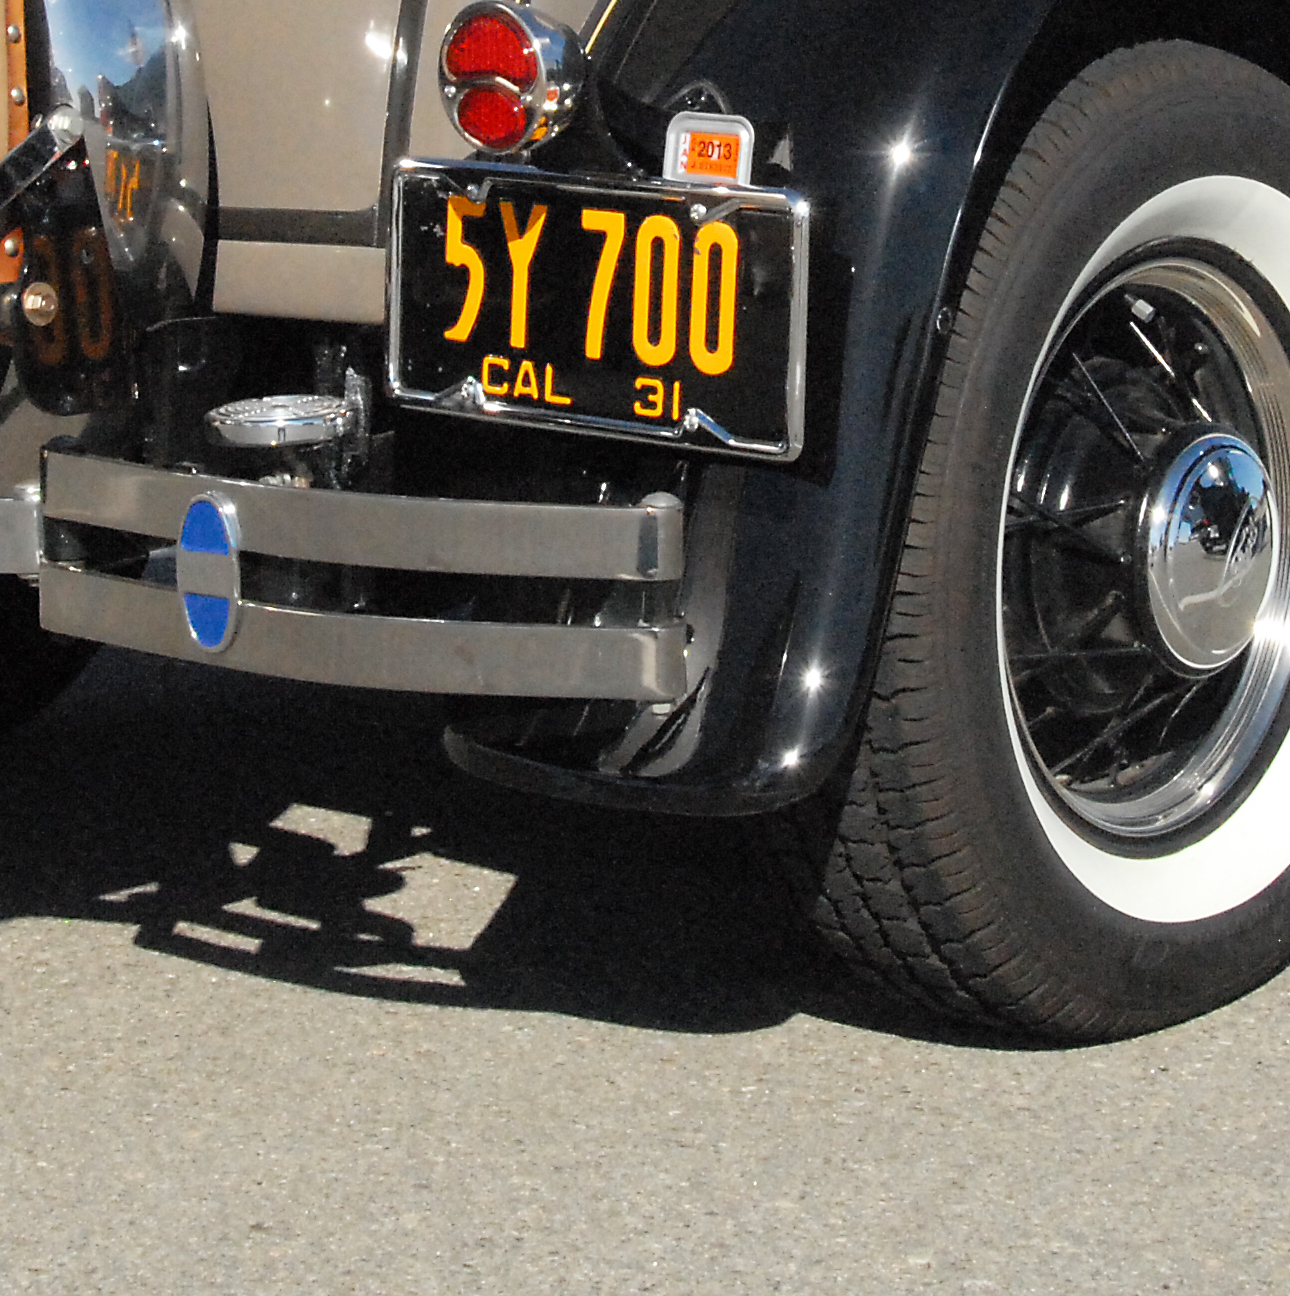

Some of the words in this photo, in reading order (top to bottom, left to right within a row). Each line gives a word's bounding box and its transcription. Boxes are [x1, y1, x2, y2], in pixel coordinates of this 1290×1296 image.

[697, 140, 733, 160] 2013
[443, 194, 548, 350] 5Y
[580, 206, 742, 378] 700
[481, 353, 573, 406] CAL
[632, 375, 682, 422] 31
